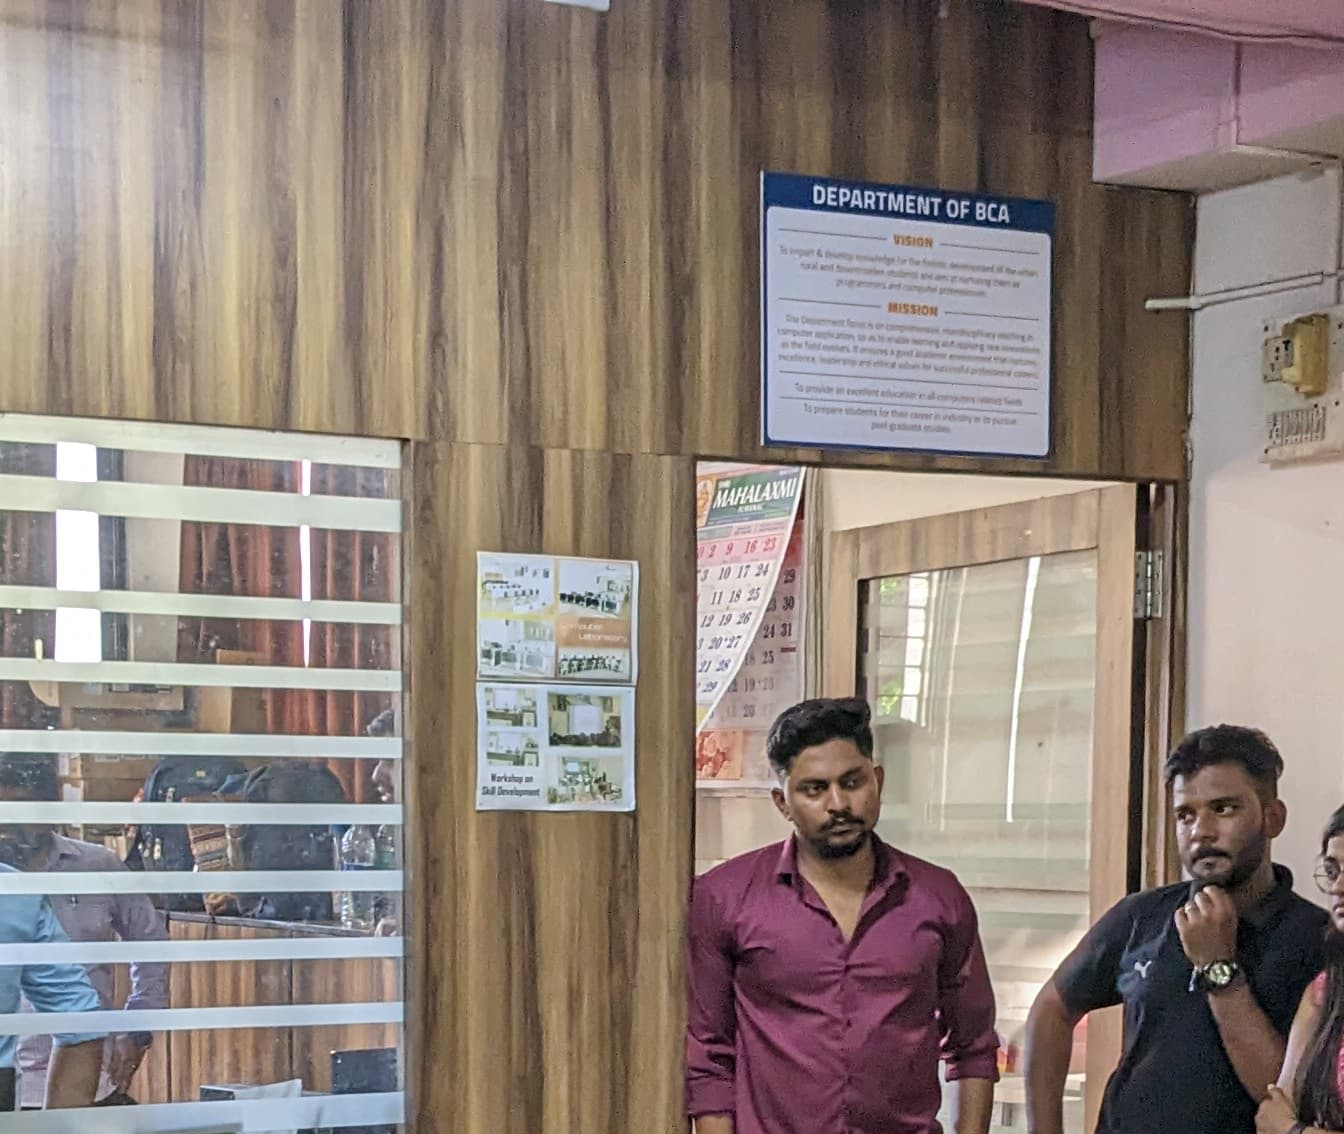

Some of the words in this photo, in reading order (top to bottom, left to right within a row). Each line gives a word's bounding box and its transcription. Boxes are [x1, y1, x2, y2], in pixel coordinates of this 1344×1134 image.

[812, 184, 942, 217] DEPARTMENT
[946, 199, 970, 219] OF
[975, 202, 1010, 223] BCA
[893, 234, 934, 249] VISION
[887, 303, 939, 317] MISSION
[713, 477, 797, 509] MAHALAXMI
[709, 544, 717, 558] 2
[725, 542, 734, 555] 9
[744, 540, 758, 554] 16
[763, 538, 777, 552] 23
[718, 566, 731, 581] 10
[736, 565, 751, 579] 17
[755, 562, 770, 577] 24
[783, 568, 796, 584] 29
[710, 591, 723, 605] 11
[728, 590, 742, 603] 18
[747, 587, 761, 601] 25
[782, 596, 795, 610] 30
[701, 614, 714, 628] 12
[718, 613, 733, 626] 19
[736, 611, 752, 625] 26
[763, 624, 775, 638] 24
[781, 623, 792, 637] 31
[708, 637, 722, 649] 20
[726, 635, 742, 648] 27
[698, 660, 711, 672] 21
[715, 658, 731, 671] 28
[762, 651, 774, 664] 25
[491, 773, 523, 784] Workshop
[481, 786, 496, 795] Skill
[497, 786, 540, 796] Development
